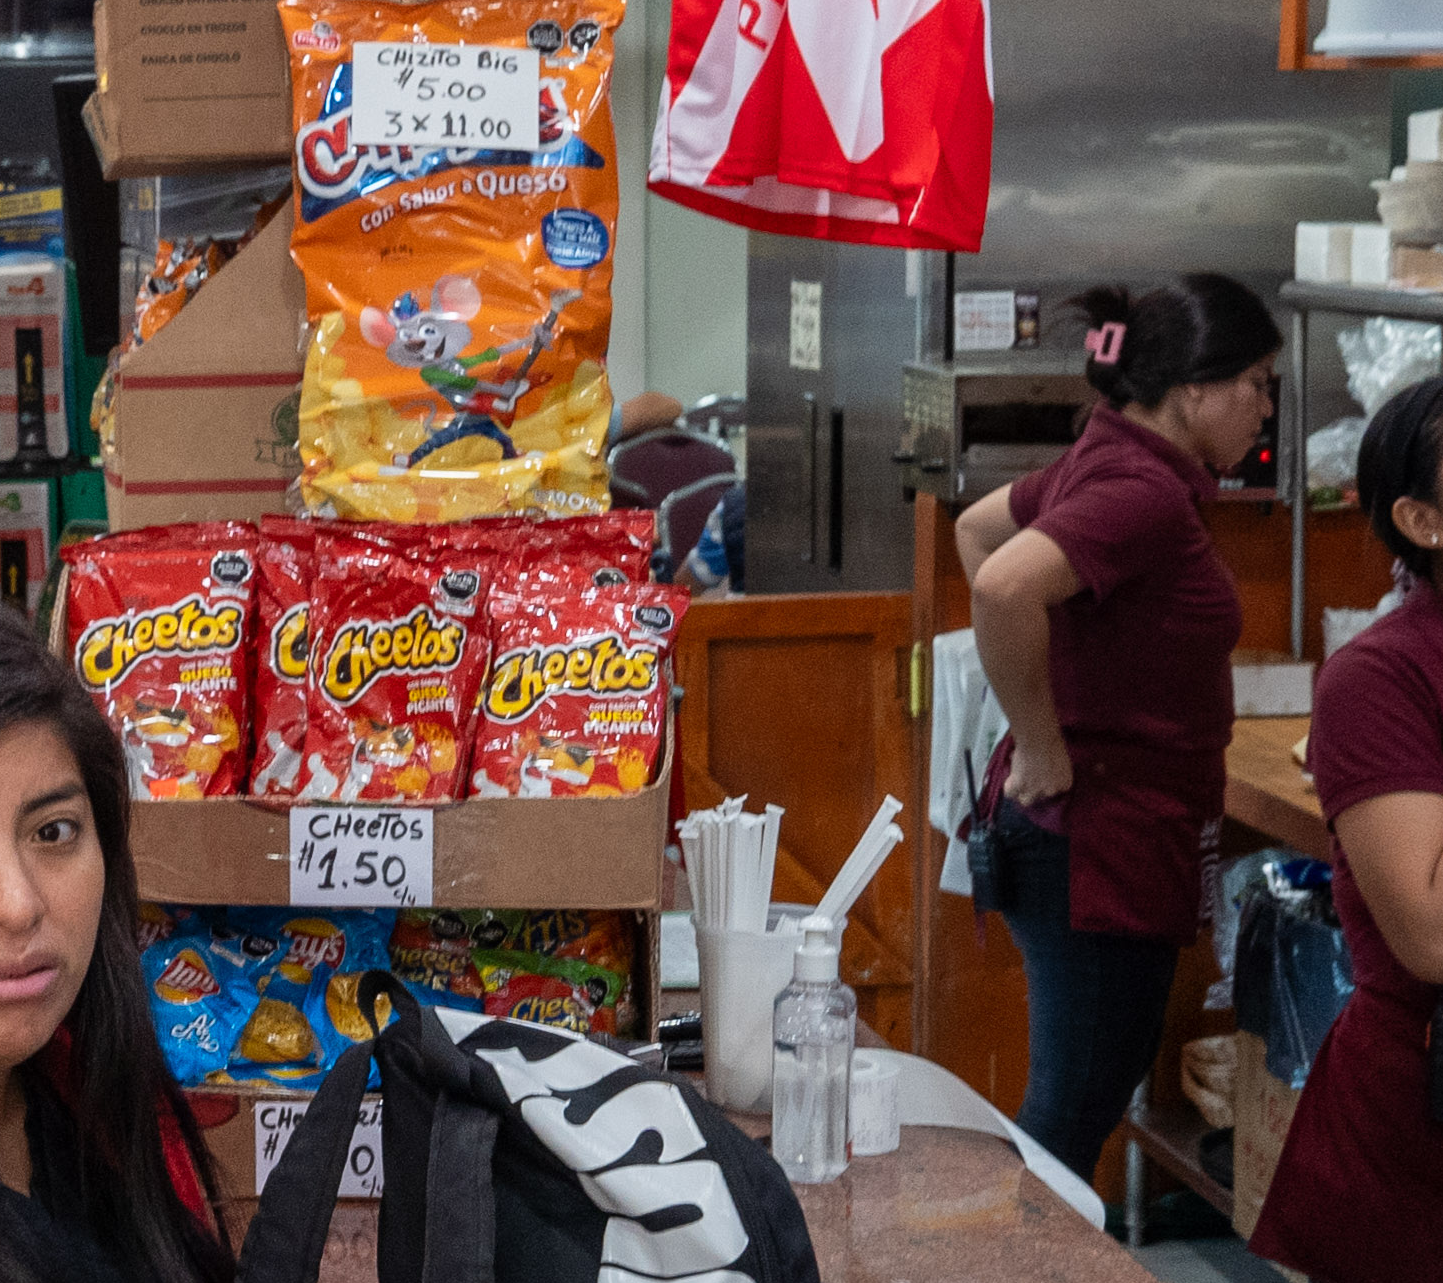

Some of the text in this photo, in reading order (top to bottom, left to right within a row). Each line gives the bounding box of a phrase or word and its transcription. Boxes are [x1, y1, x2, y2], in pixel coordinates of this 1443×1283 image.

[384, 109, 403, 139] 3
[360, 202, 395, 234] con
[399, 178, 456, 214] Sabor
[476, 171, 569, 202] Queso
[78, 597, 240, 689] Cheetos
[323, 607, 467, 704] Cheetos
[486, 636, 656, 721] Cheetos
[315, 851, 409, 890] 1.50
